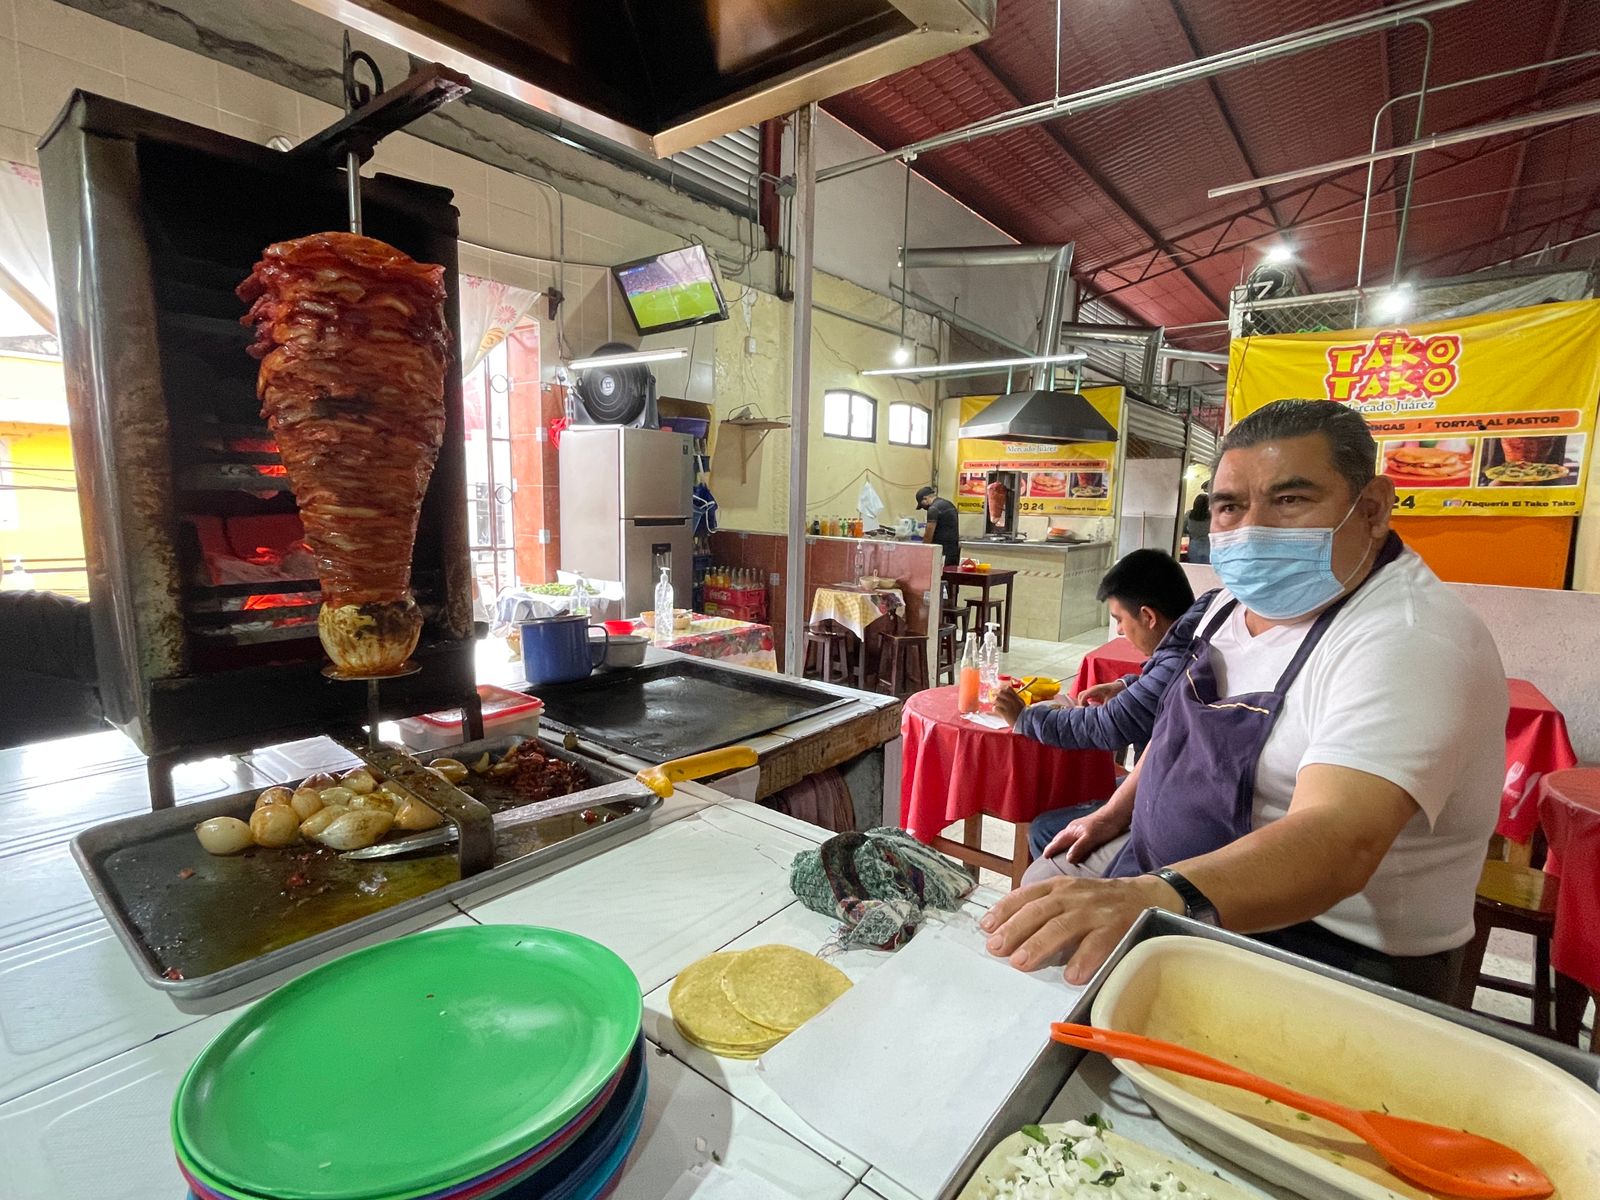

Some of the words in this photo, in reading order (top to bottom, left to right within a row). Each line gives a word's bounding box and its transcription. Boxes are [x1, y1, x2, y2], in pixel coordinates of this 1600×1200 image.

[1331, 339, 1456, 372] TAKO
[1329, 367, 1452, 398] TAKO
[1394, 400, 1435, 413] Juárez
[1435, 419, 1484, 429] TORTAS
[1487, 418, 1503, 427] AL
[1507, 416, 1560, 426] PASTOR
